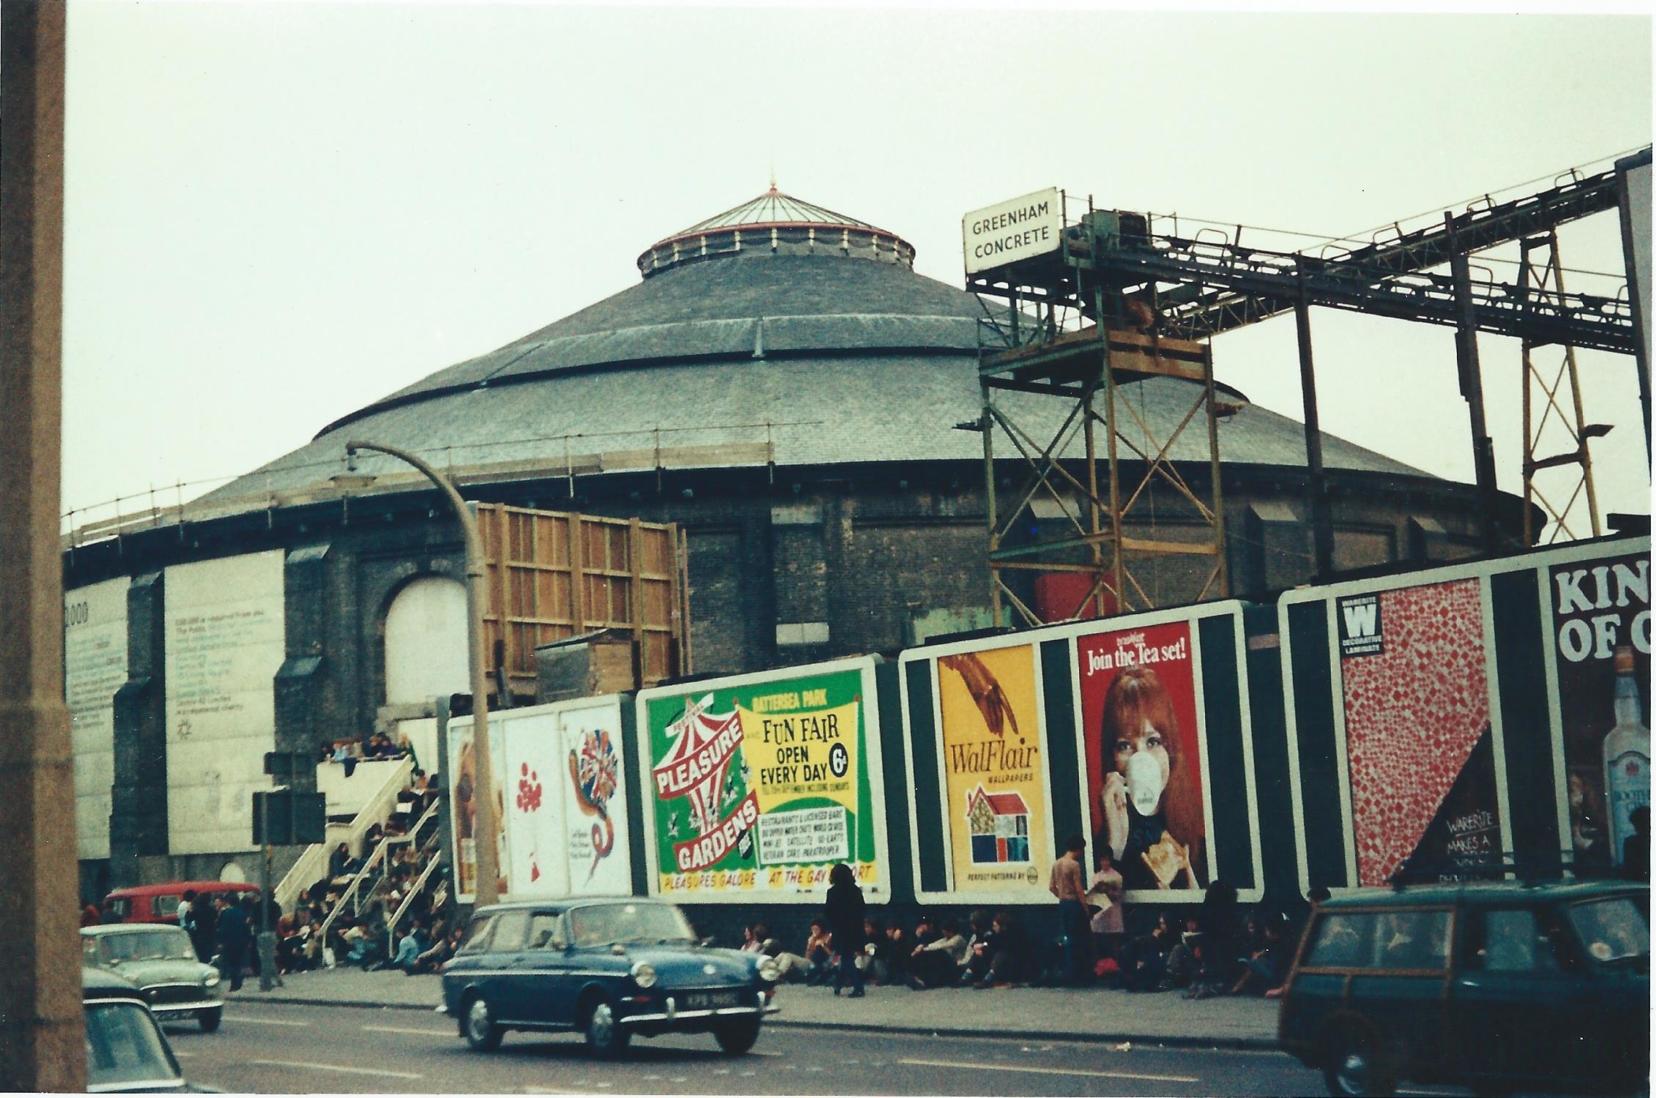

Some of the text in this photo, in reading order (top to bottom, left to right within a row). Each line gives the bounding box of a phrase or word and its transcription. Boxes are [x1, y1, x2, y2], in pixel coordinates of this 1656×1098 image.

[972, 201, 1049, 235] GREENHAM
[974, 226, 1049, 259] CONCRETE
[1343, 604, 1377, 639] W
[1559, 613, 1621, 662] OF
[1087, 648, 1113, 677] Join
[1115, 646, 1135, 668] the
[1134, 642, 1160, 665] Tea
[1161, 637, 1186, 662] set!
[752, 688, 828, 712] BATTERSEA PARK
[762, 713, 840, 745] FUN FAIR
[656, 718, 742, 794] PLEASURE
[776, 745, 809, 764] OPEN
[950, 737, 1038, 774] WalFlair
[761, 763, 828, 785] EVERY DAY
[988, 772, 1034, 785] WALLPAPERS
[678, 799, 757, 871] GARDENS
[1448, 834, 1490, 852] MAKES A
[664, 872, 717, 890] PLEASURES
[720, 871, 756, 888] GALORE
[769, 871, 782, 884] AT
[785, 870, 802, 883] THE
[807, 869, 827, 883] GAY
